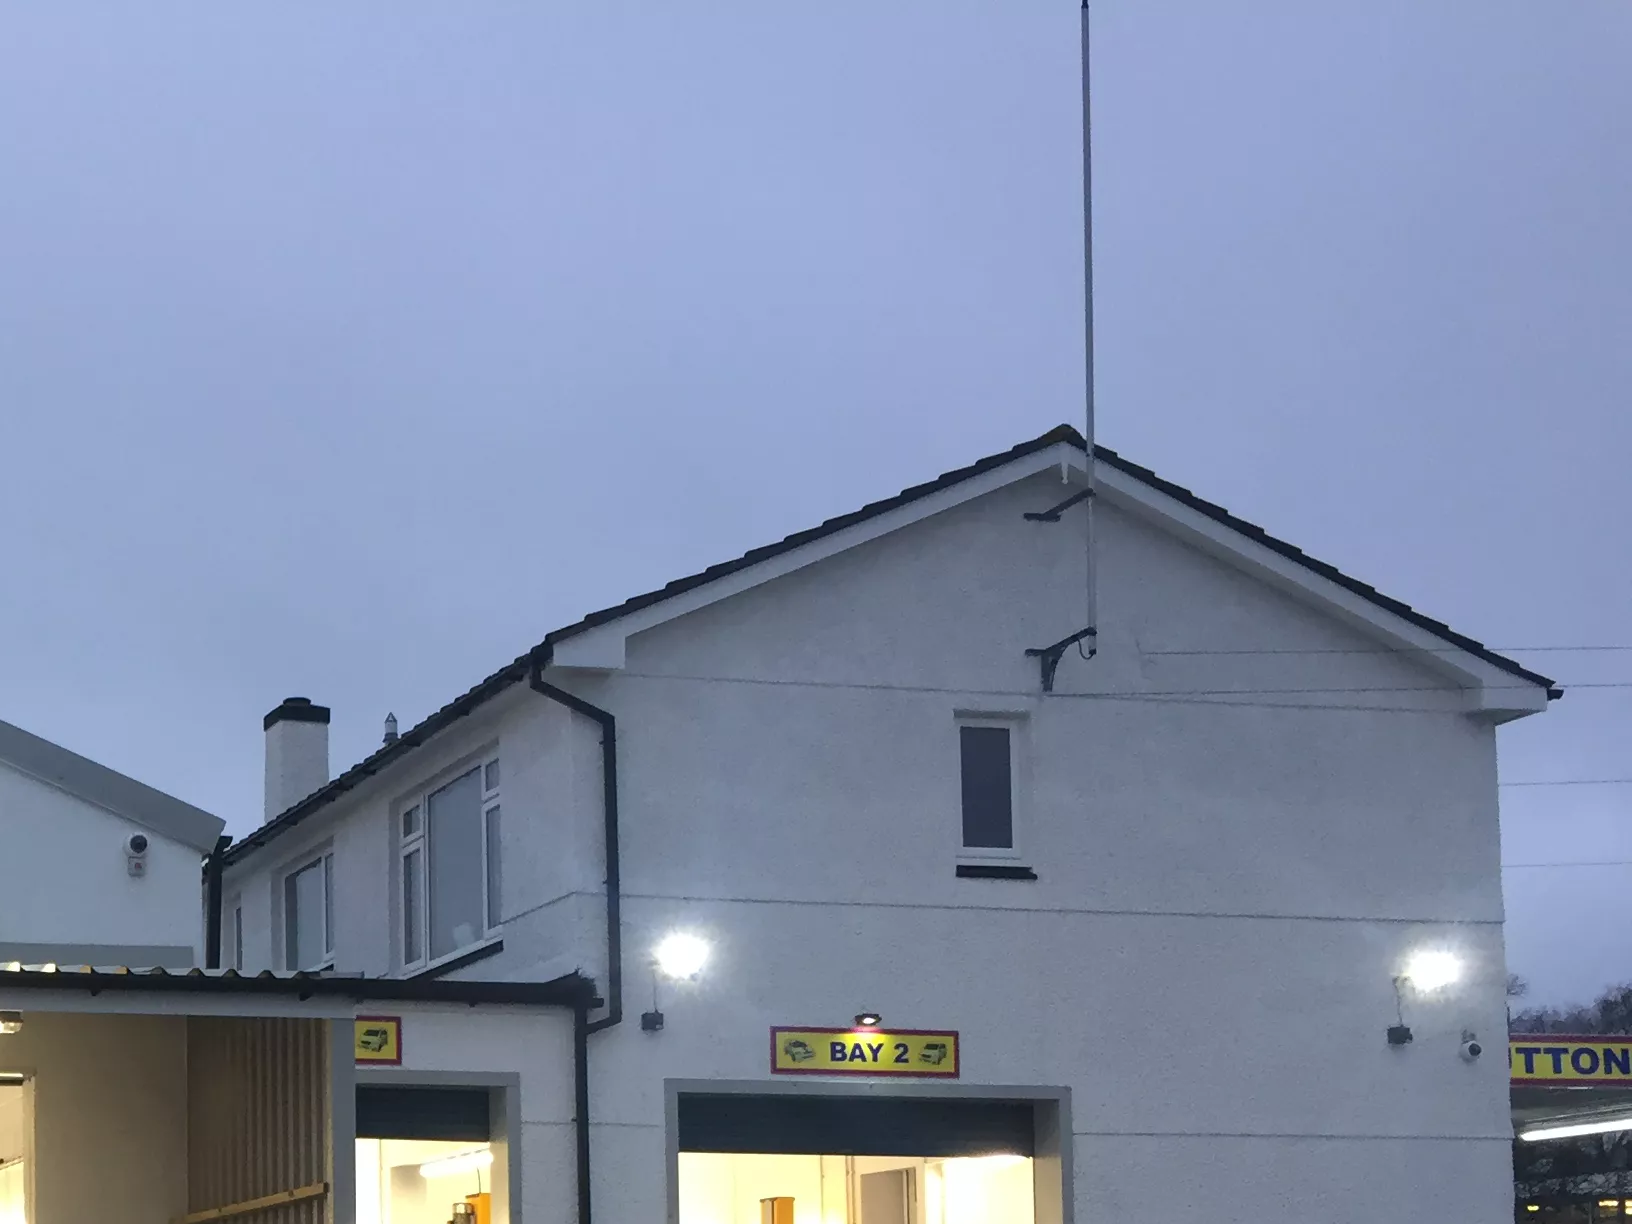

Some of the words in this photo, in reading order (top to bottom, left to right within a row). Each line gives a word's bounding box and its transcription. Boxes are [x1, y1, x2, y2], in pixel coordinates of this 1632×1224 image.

[829, 1041, 884, 1063] BAY
[893, 1042, 909, 1063] 2
[1509, 1047, 1631, 1075] TTON
